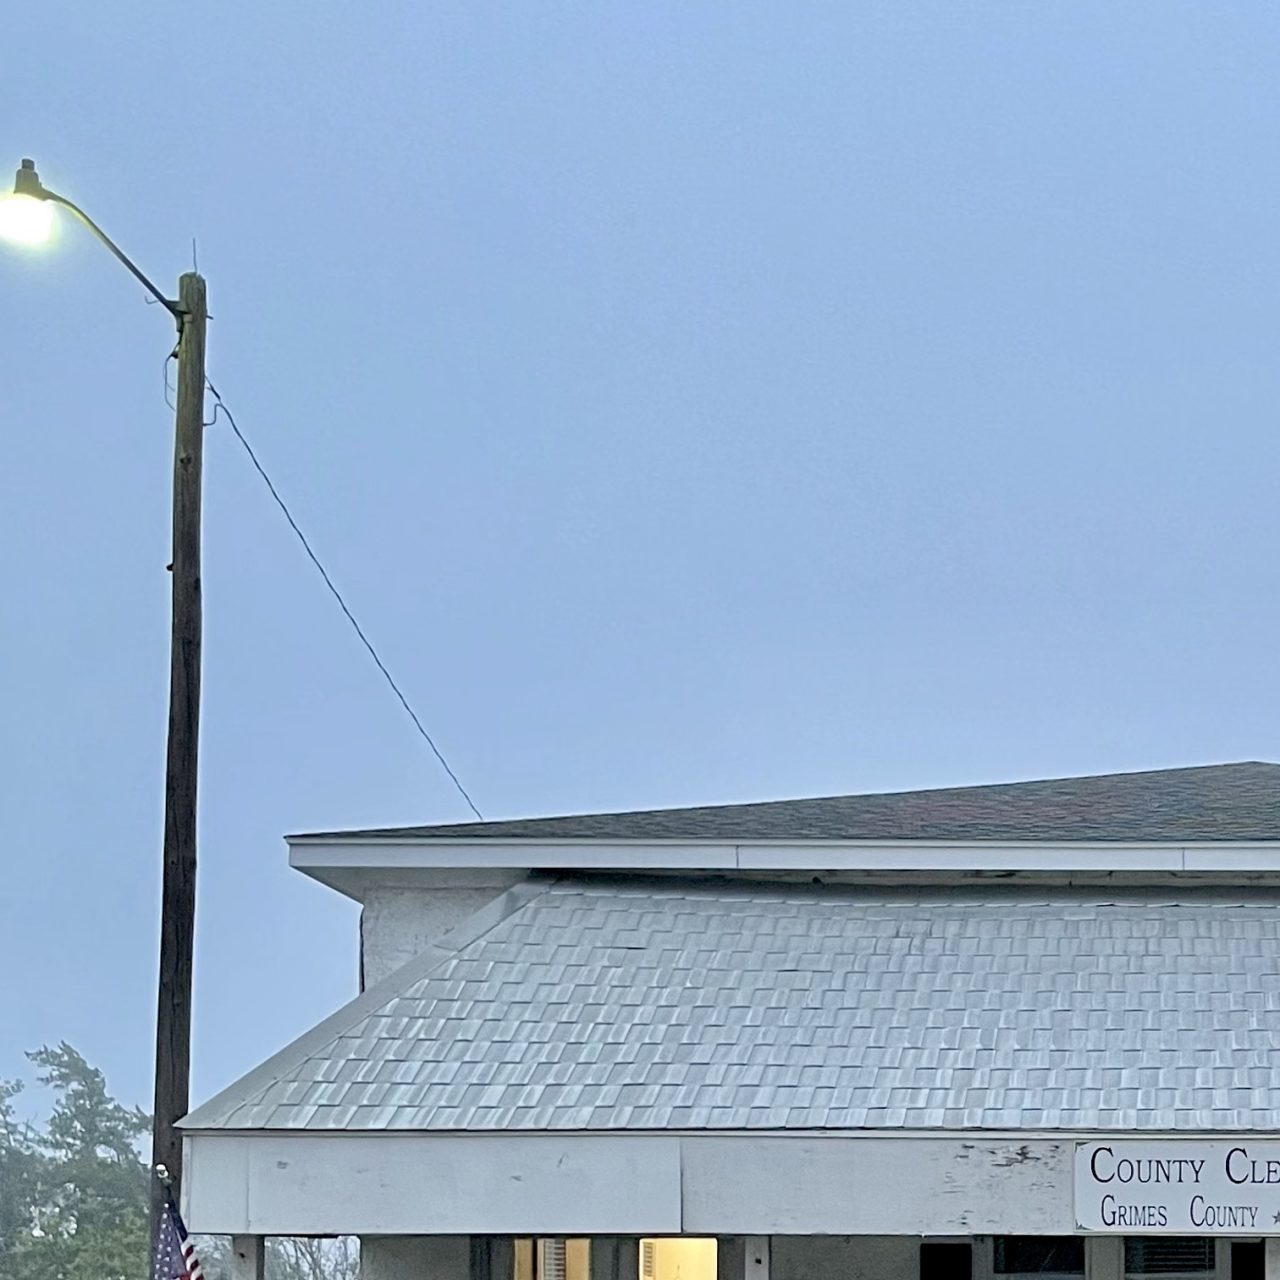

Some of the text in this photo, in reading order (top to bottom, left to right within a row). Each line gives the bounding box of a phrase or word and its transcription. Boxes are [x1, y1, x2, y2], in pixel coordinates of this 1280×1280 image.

[1090, 1147, 1206, 1184] COUNTY
[1101, 1194, 1168, 1227] GRIMES
[1190, 1195, 1259, 1228] COUNTY
